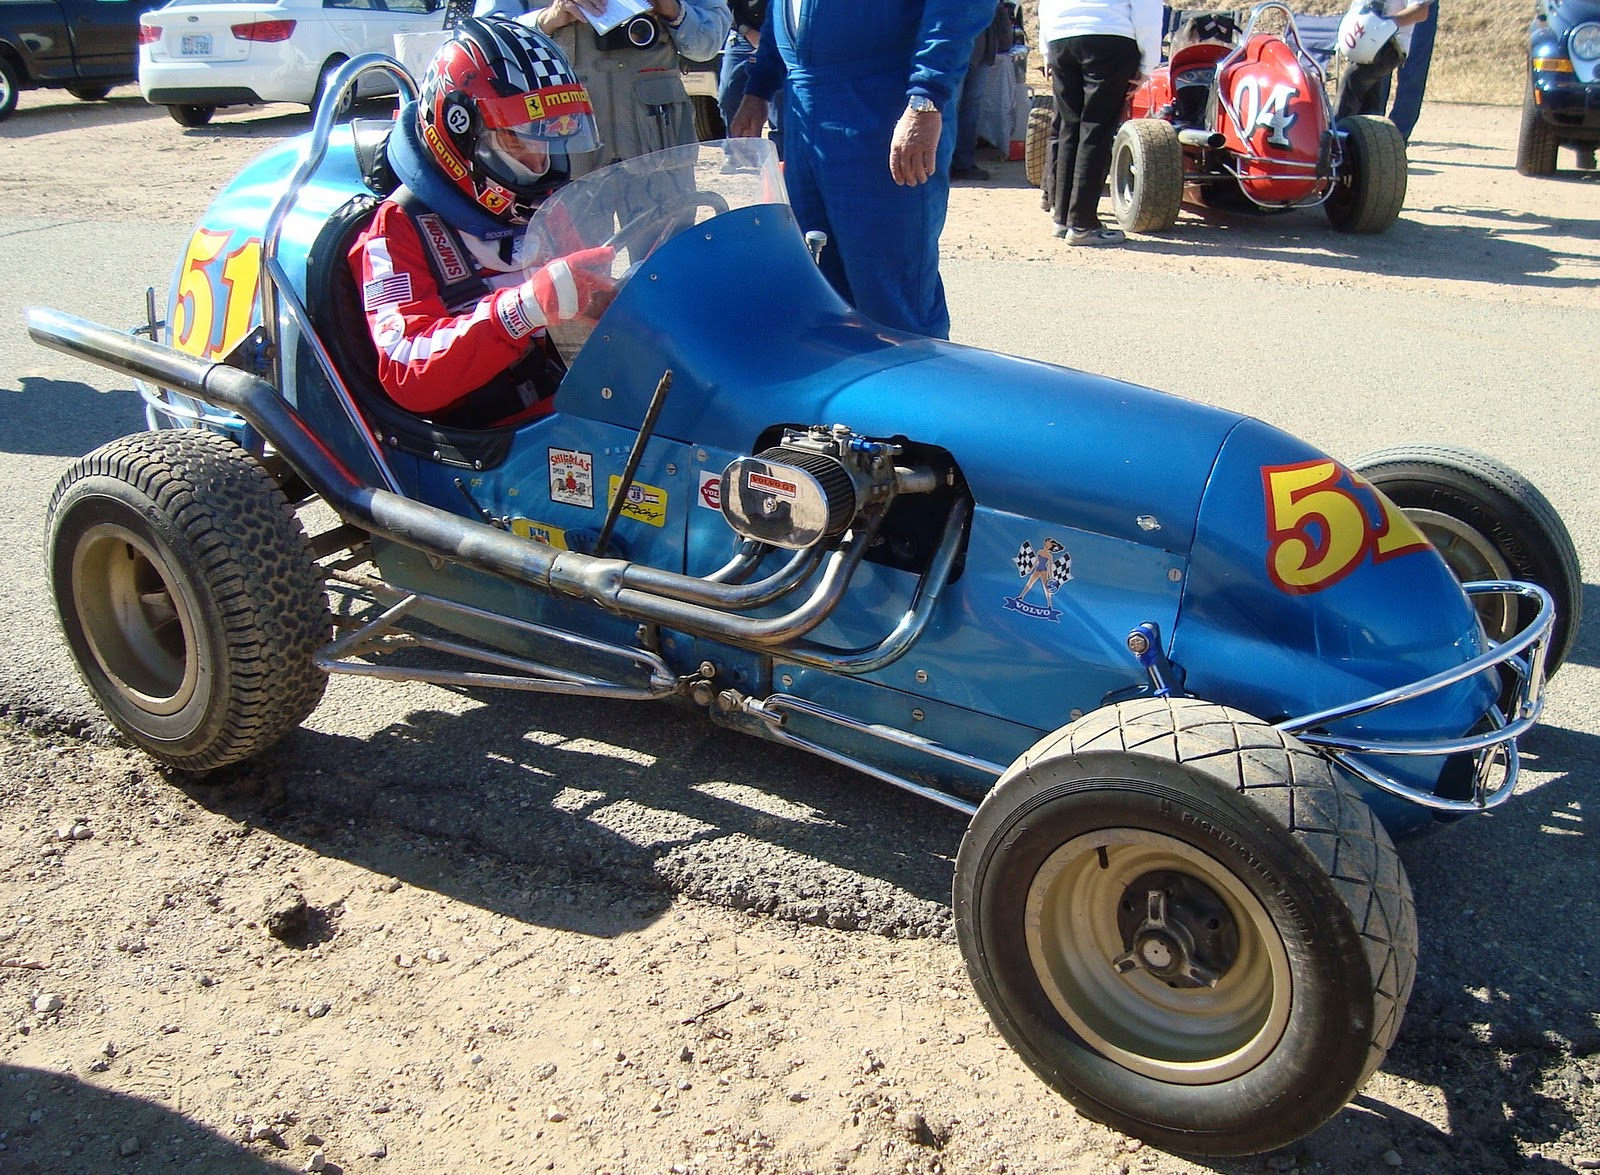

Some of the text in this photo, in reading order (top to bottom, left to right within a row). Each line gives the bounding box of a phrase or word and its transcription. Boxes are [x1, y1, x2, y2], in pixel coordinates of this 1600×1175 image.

[1344, 21, 1365, 48] 04
[449, 110, 468, 132] 62
[1233, 77, 1299, 150] 04
[425, 221, 462, 276] SIMPSON
[172, 227, 261, 361] 51
[703, 488, 720, 498] VOL
[752, 475, 781, 488] VOLVO
[782, 483, 795, 493] GT
[1260, 458, 1434, 595] 51
[1015, 601, 1051, 616] VOLVO
